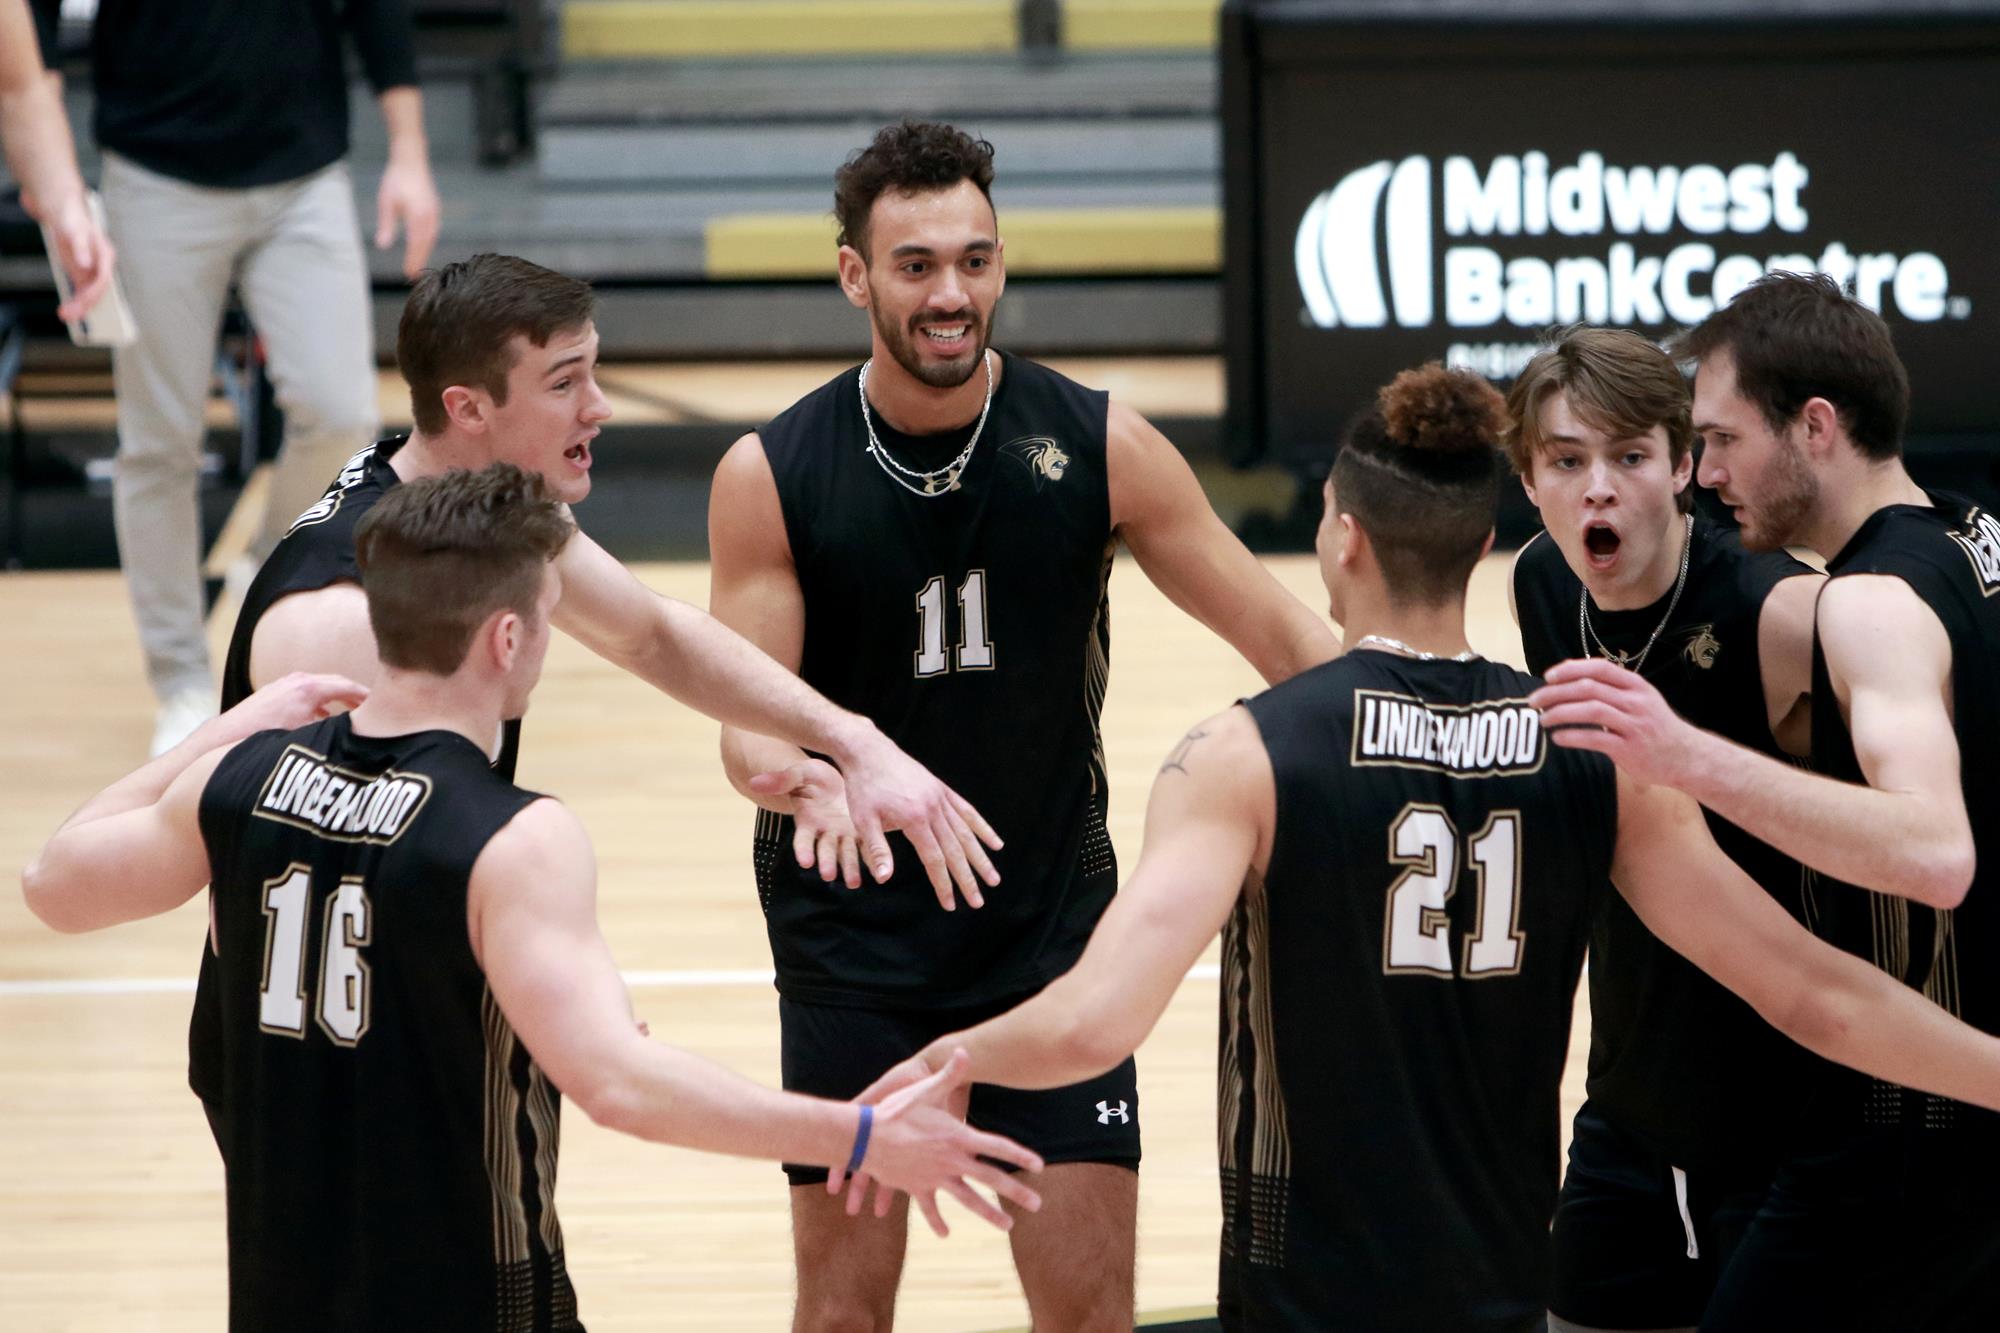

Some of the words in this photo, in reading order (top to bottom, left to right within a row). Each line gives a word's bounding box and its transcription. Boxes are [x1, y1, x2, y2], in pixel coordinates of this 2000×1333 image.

[1443, 150, 1809, 236] Midwest
[913, 568, 996, 679] 11
[258, 861, 373, 1048] 16
[1382, 801, 1527, 980] 21
